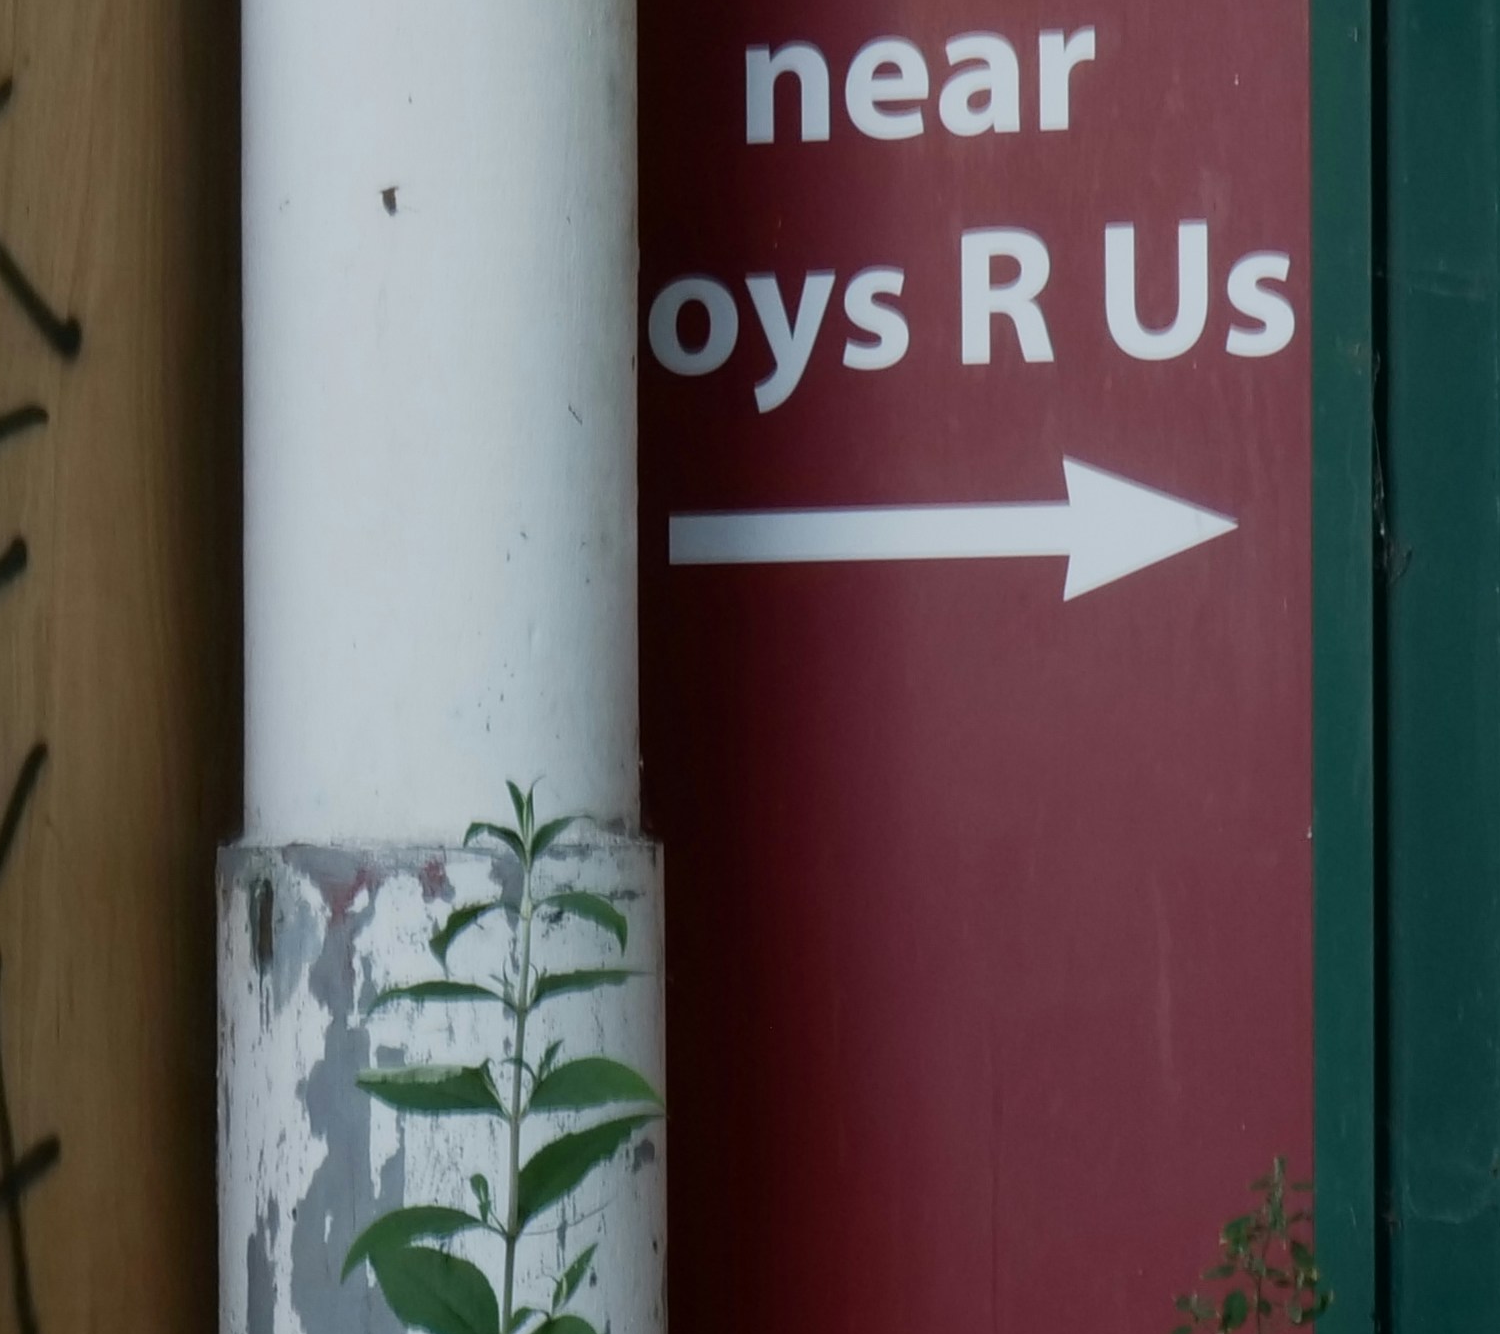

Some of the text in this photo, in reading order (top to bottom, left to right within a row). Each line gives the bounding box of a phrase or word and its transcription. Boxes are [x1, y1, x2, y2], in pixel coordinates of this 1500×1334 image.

[744, 24, 1096, 145] near
[648, 220, 1295, 415] oys R Us
